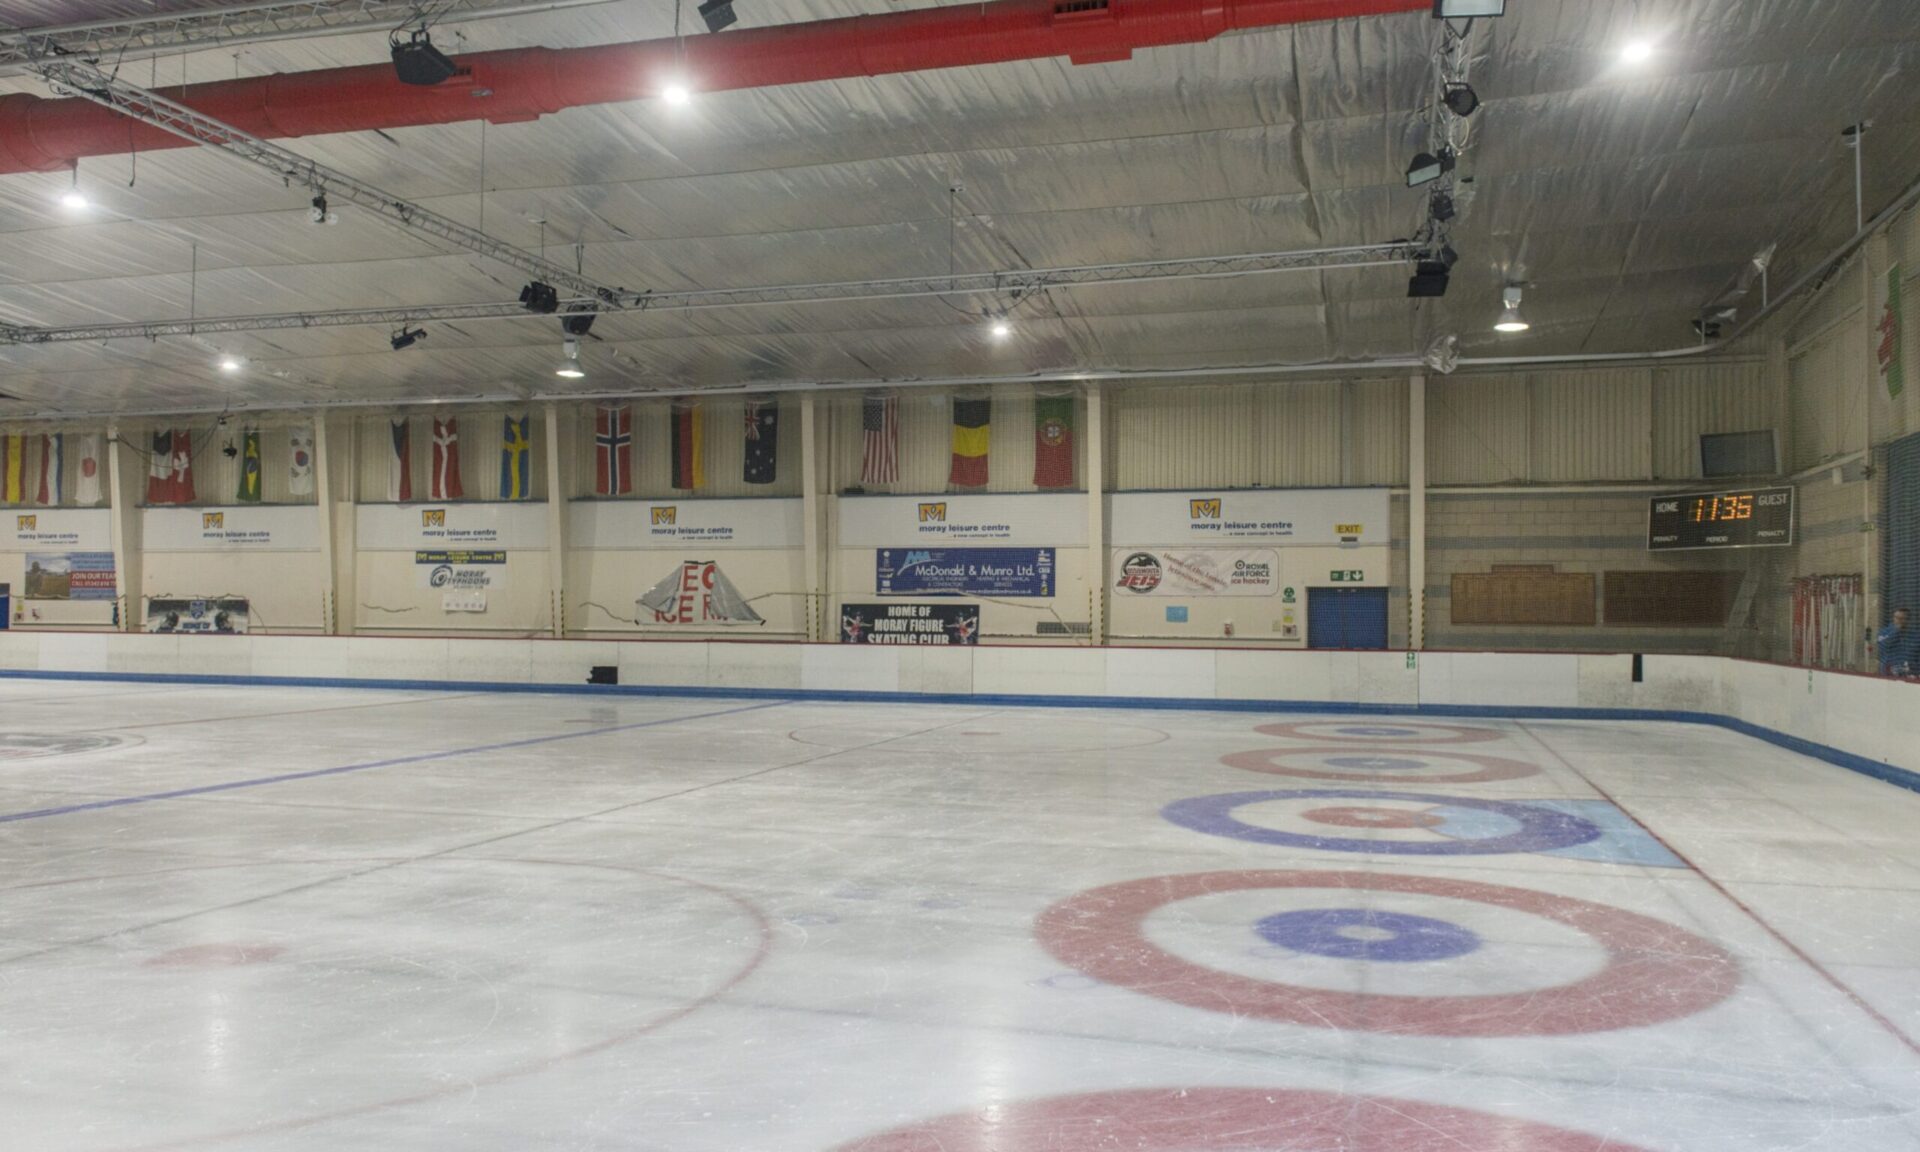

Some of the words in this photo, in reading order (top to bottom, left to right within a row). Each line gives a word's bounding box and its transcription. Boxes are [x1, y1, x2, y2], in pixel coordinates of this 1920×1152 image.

[1656, 502, 1679, 513] HOME
[1758, 494, 1787, 505] GUEST
[1191, 523, 1221, 531] moray
[1260, 521, 1293, 529] centre
[1338, 525, 1359, 533] EXIT
[915, 564, 965, 576] McDonald
[969, 565, 977, 576] &
[981, 565, 1014, 576] Munro
[1017, 564, 1035, 576] Ltd.
[447, 577, 491, 585] TYPHOONS
[1243, 577, 1270, 585] hockey
[888, 606, 917, 616] HOME
[919, 606, 931, 616] OF
[874, 619, 907, 632] MORAY
[910, 619, 944, 632] FIGURE
[868, 633, 917, 644] SKATING
[920, 634, 950, 644] CLUB
